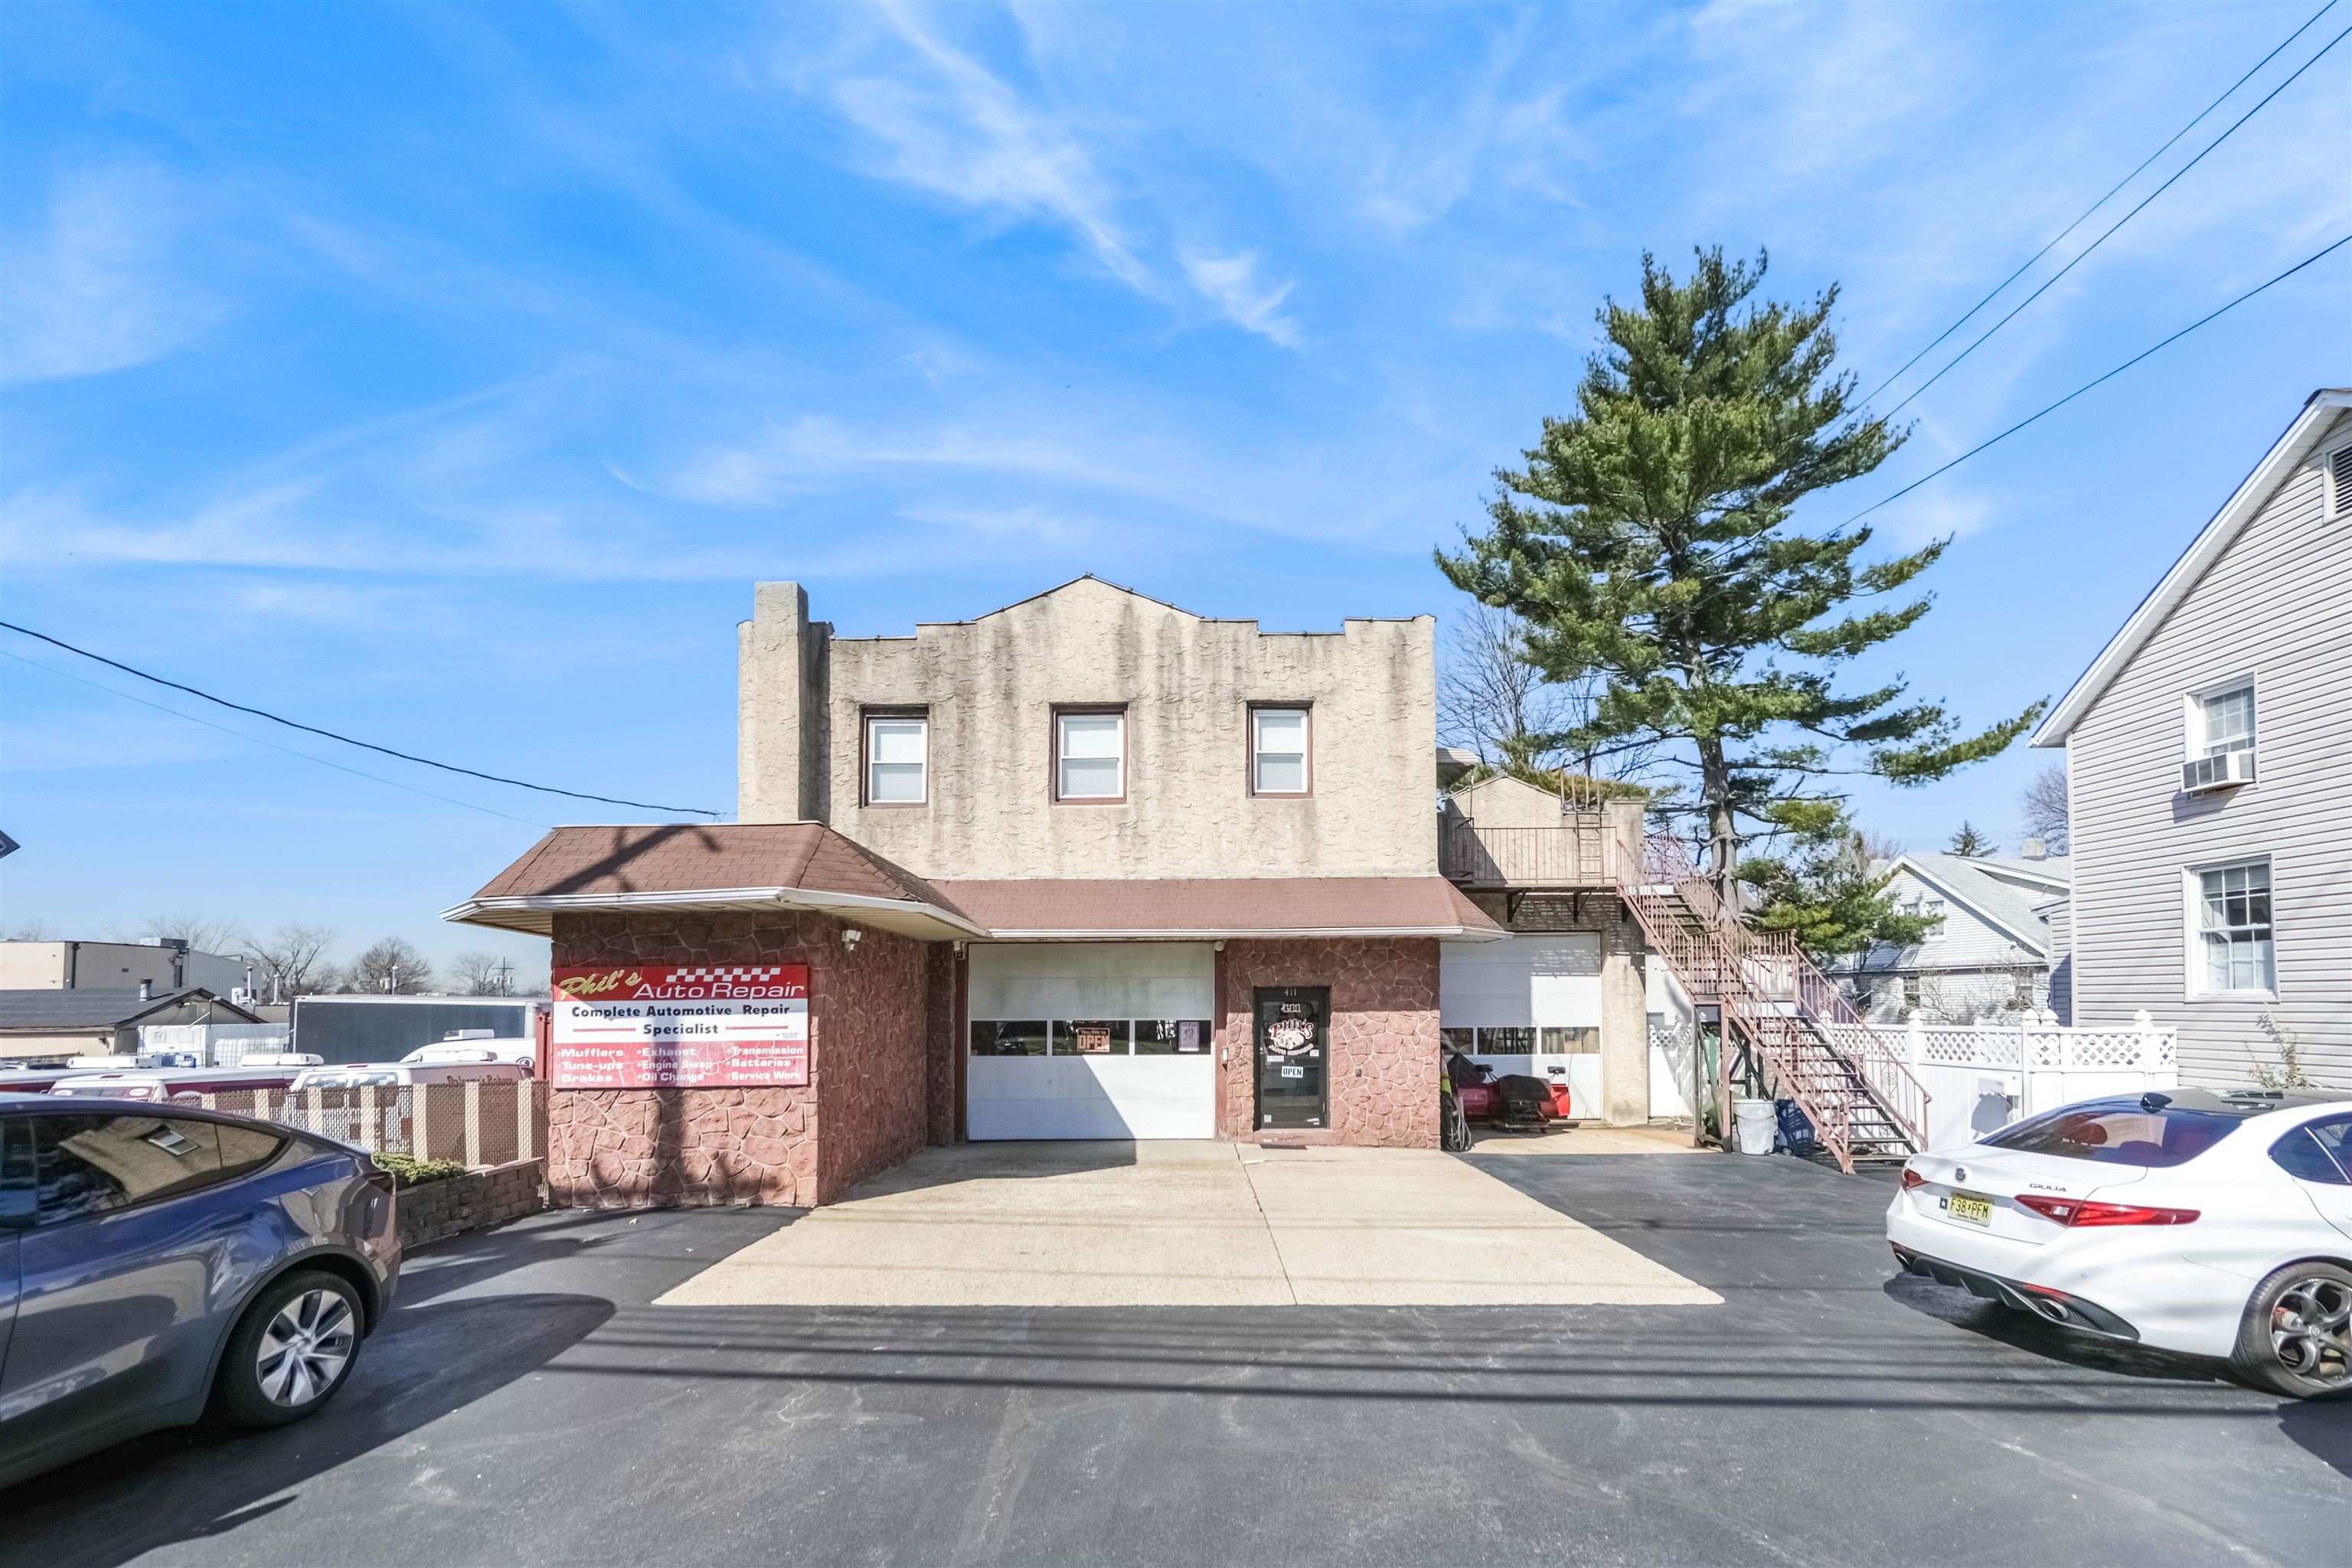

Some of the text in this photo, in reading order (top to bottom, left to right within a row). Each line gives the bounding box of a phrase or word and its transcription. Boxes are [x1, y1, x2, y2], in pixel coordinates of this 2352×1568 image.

[557, 969, 642, 1001] Phil's
[632, 982, 805, 999] Auto Repair
[572, 1004, 790, 1019] Complete Automotive Repair
[643, 1024, 718, 1036] Specialist
[1078, 1035, 1109, 1050] OPEN
[561, 1048, 624, 1057] Mufflers
[642, 1047, 697, 1057] Exhaust
[731, 1046, 804, 1055] Transmission
[562, 1061, 624, 1071] Tune-ups
[642, 1060, 713, 1071] Engine Swap
[731, 1058, 792, 1067] Batteries
[731, 1071, 802, 1080] Service Work
[1282, 1067, 1302, 1076] OPEN
[561, 1073, 613, 1083] Brakes
[642, 1072, 704, 1083] Oil Change
[2030, 1183, 2066, 1192] GIULIA
